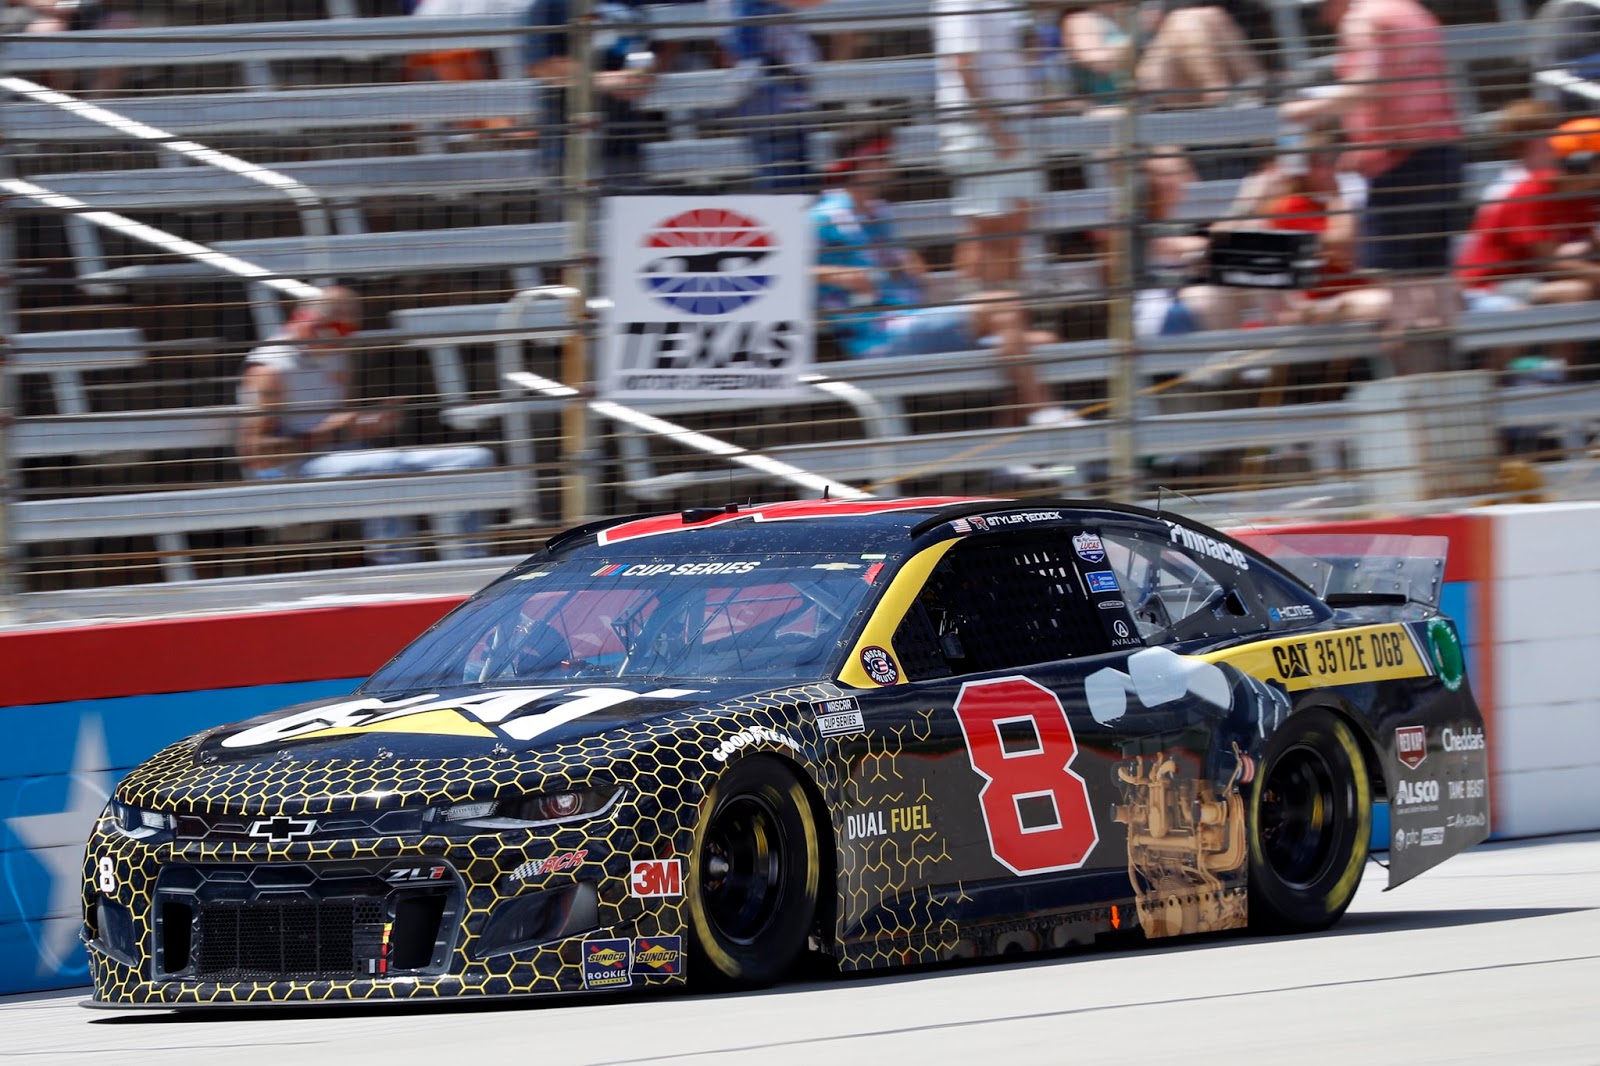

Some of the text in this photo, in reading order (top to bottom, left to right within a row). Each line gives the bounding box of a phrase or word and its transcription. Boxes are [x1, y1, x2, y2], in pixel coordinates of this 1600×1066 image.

[617, 321, 799, 369] TEXAS
[1080, 541, 1100, 550] LUCAS
[1169, 523, 1249, 570] Pinnacle
[622, 561, 761, 576] CUP SERIES
[1112, 637, 1141, 647] AVALAN
[863, 649, 887, 664] NASCAR
[1272, 632, 1404, 679] CAT 3512E DGB
[871, 668, 897, 683] SALUTES
[826, 699, 852, 713] NASCAR
[823, 715, 857, 729] CUP SERIES
[712, 726, 801, 762] GOODYEAR
[1442, 727, 1485, 752] Cheddar's
[953, 675, 1099, 877] 8
[847, 805, 931, 839] DUAL FUEL
[538, 850, 588, 874] RCR
[99, 856, 116, 893] 8
[385, 866, 446, 882] ZL1
[633, 862, 680, 895] 3M
[589, 952, 626, 962] SUNOCO
[637, 951, 677, 962] SUNOCO
[587, 969, 626, 980] ROOKIE
